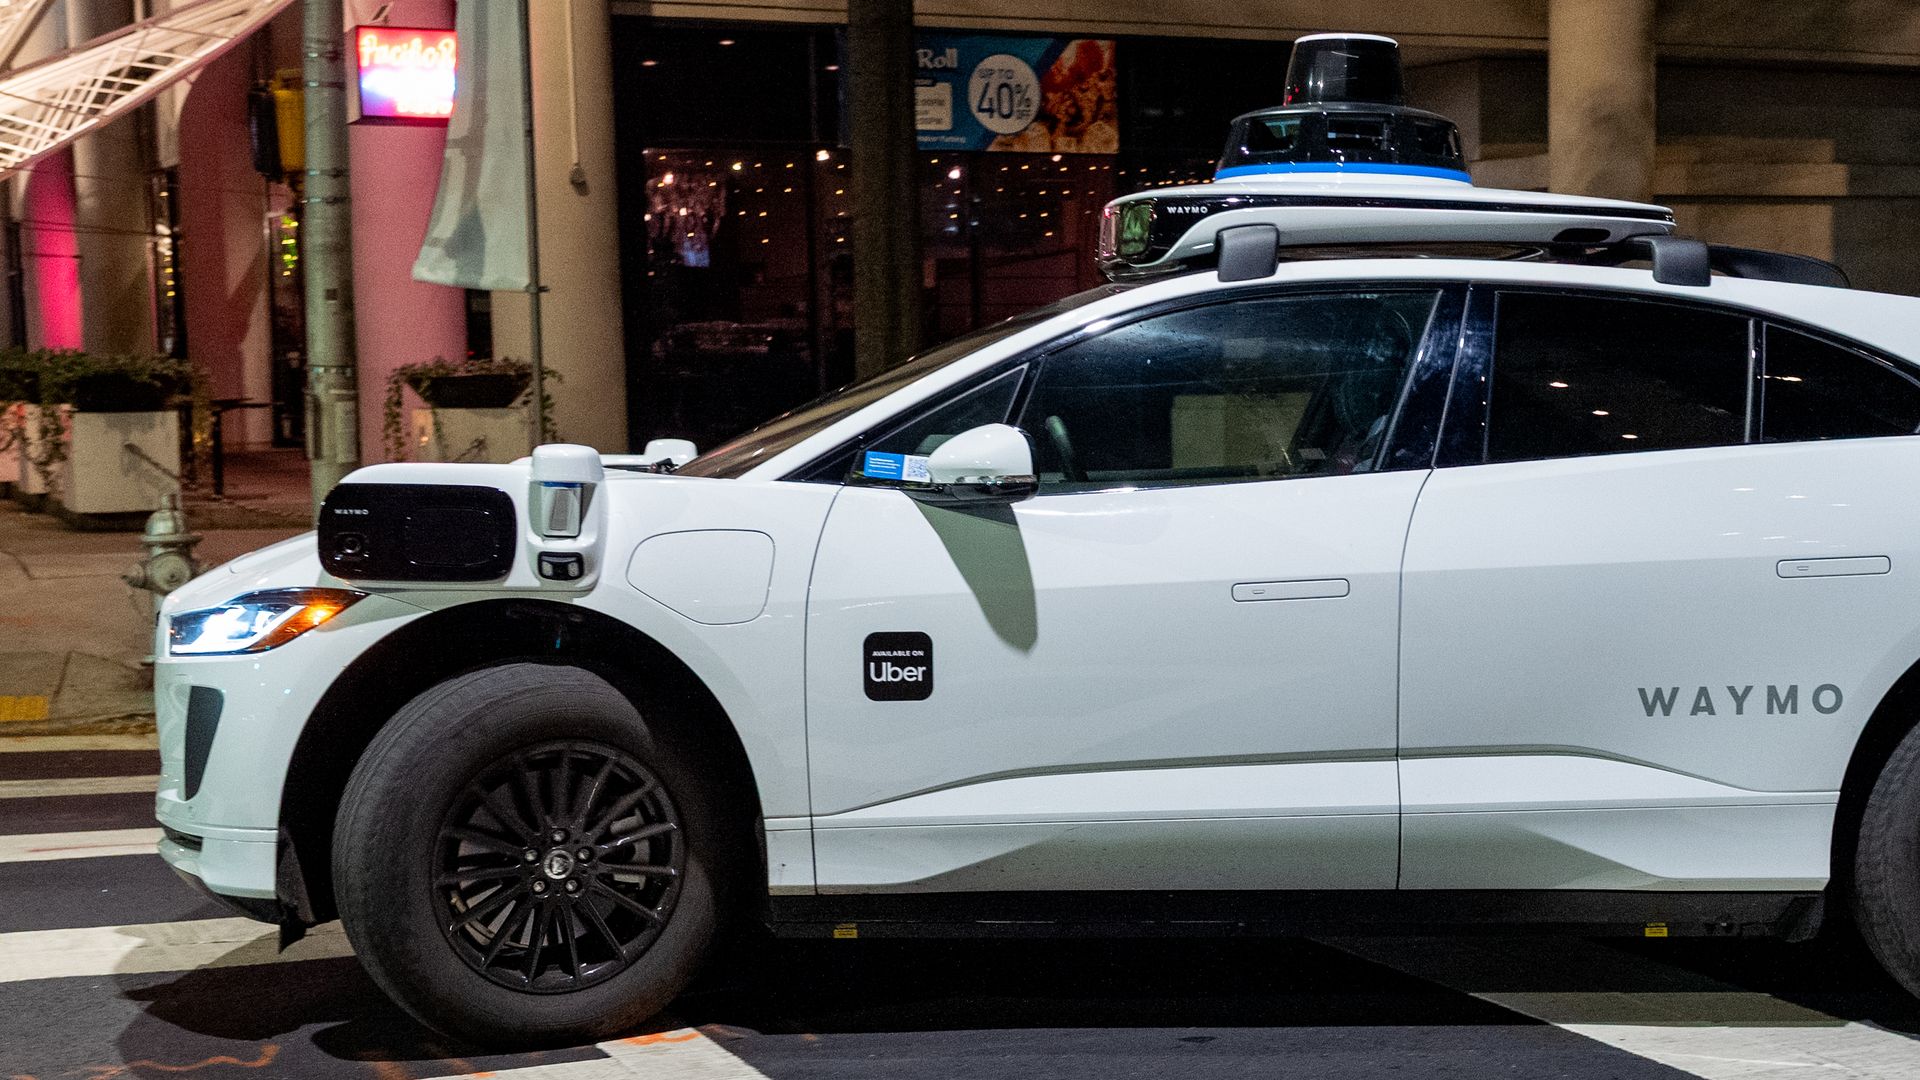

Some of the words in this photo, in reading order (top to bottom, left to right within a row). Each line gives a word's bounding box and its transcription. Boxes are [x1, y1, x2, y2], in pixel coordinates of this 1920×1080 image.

[916, 48, 958, 69] Roll
[978, 68, 995, 79] UP
[997, 68, 1015, 80] TO
[977, 81, 1031, 119] 40%
[1166, 205, 1208, 214] WAYMO
[869, 661, 927, 682] Uber
[1637, 683, 1844, 717] WAYMO
